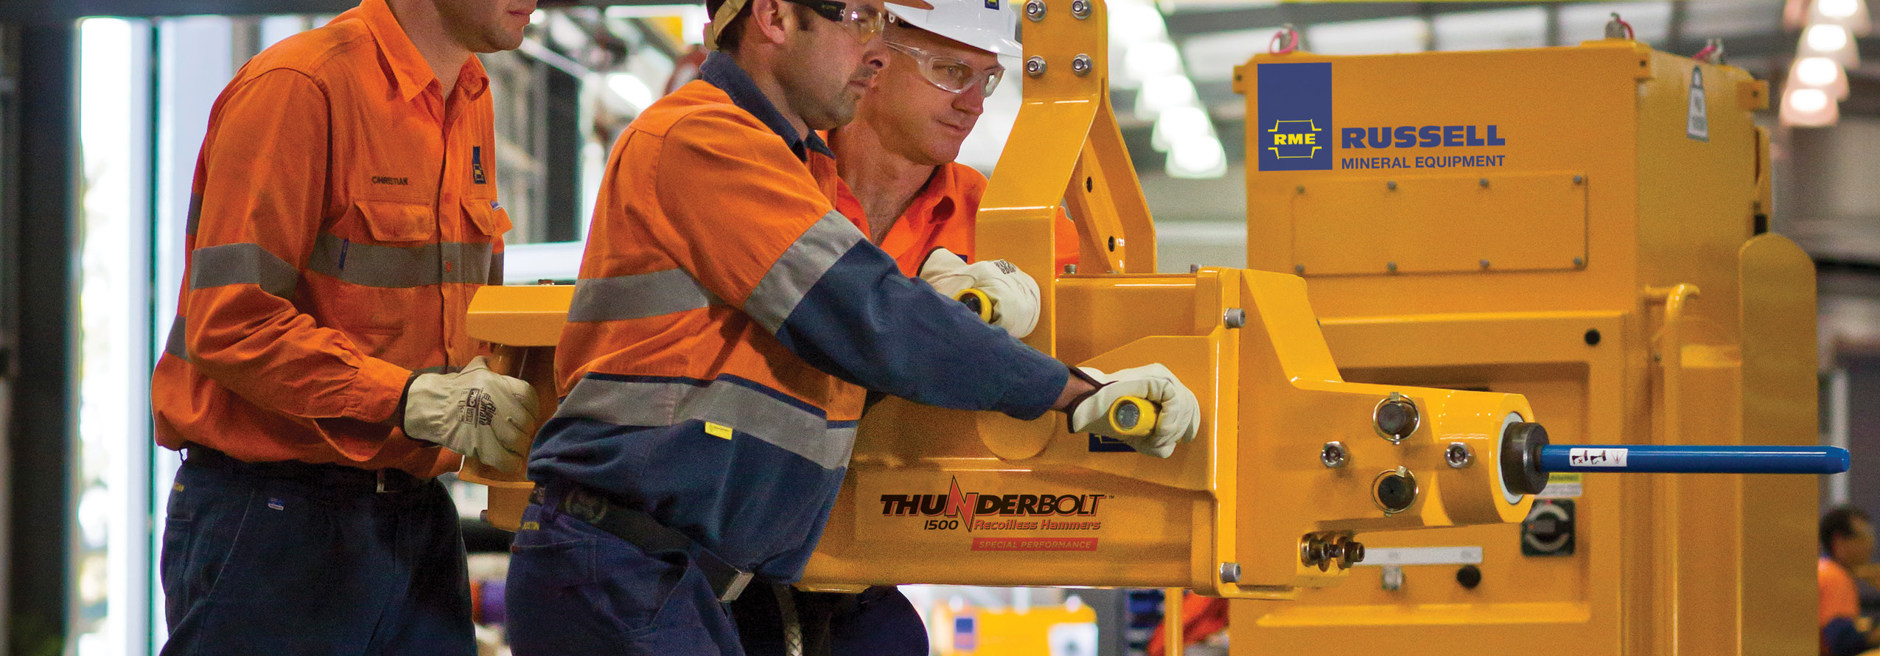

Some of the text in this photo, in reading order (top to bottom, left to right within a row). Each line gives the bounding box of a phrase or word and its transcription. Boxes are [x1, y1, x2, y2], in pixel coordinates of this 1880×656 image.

[1274, 133, 1316, 145] RME
[1341, 125, 1506, 149] RUSSELL
[1341, 155, 1506, 170] MINERAL EQUIPMENT
[371, 176, 409, 185] CHRISTIAN
[880, 475, 1107, 532] THUNDERBOLT
[924, 519, 1101, 531] 1500 Recoilless Hammers
[979, 540, 1092, 549] SPECIAL PERFORMANCE
